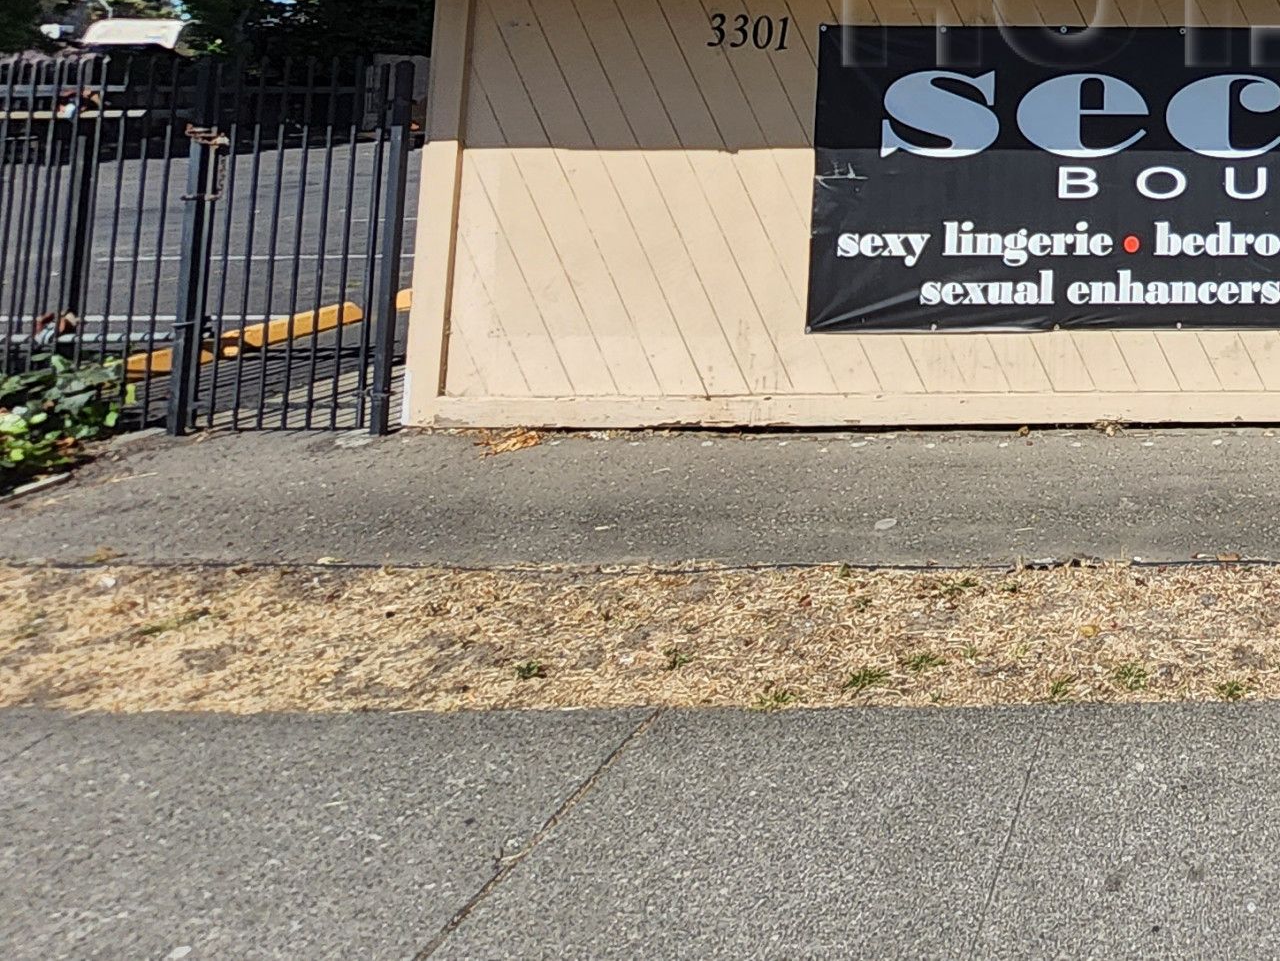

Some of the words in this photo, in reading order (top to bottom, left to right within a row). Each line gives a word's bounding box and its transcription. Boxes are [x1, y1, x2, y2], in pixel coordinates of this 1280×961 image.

[706, 12, 790, 51] 3301
[836, 232, 931, 267] sexy
[942, 221, 1114, 266] lingerie
[919, 269, 1056, 306] sexual
